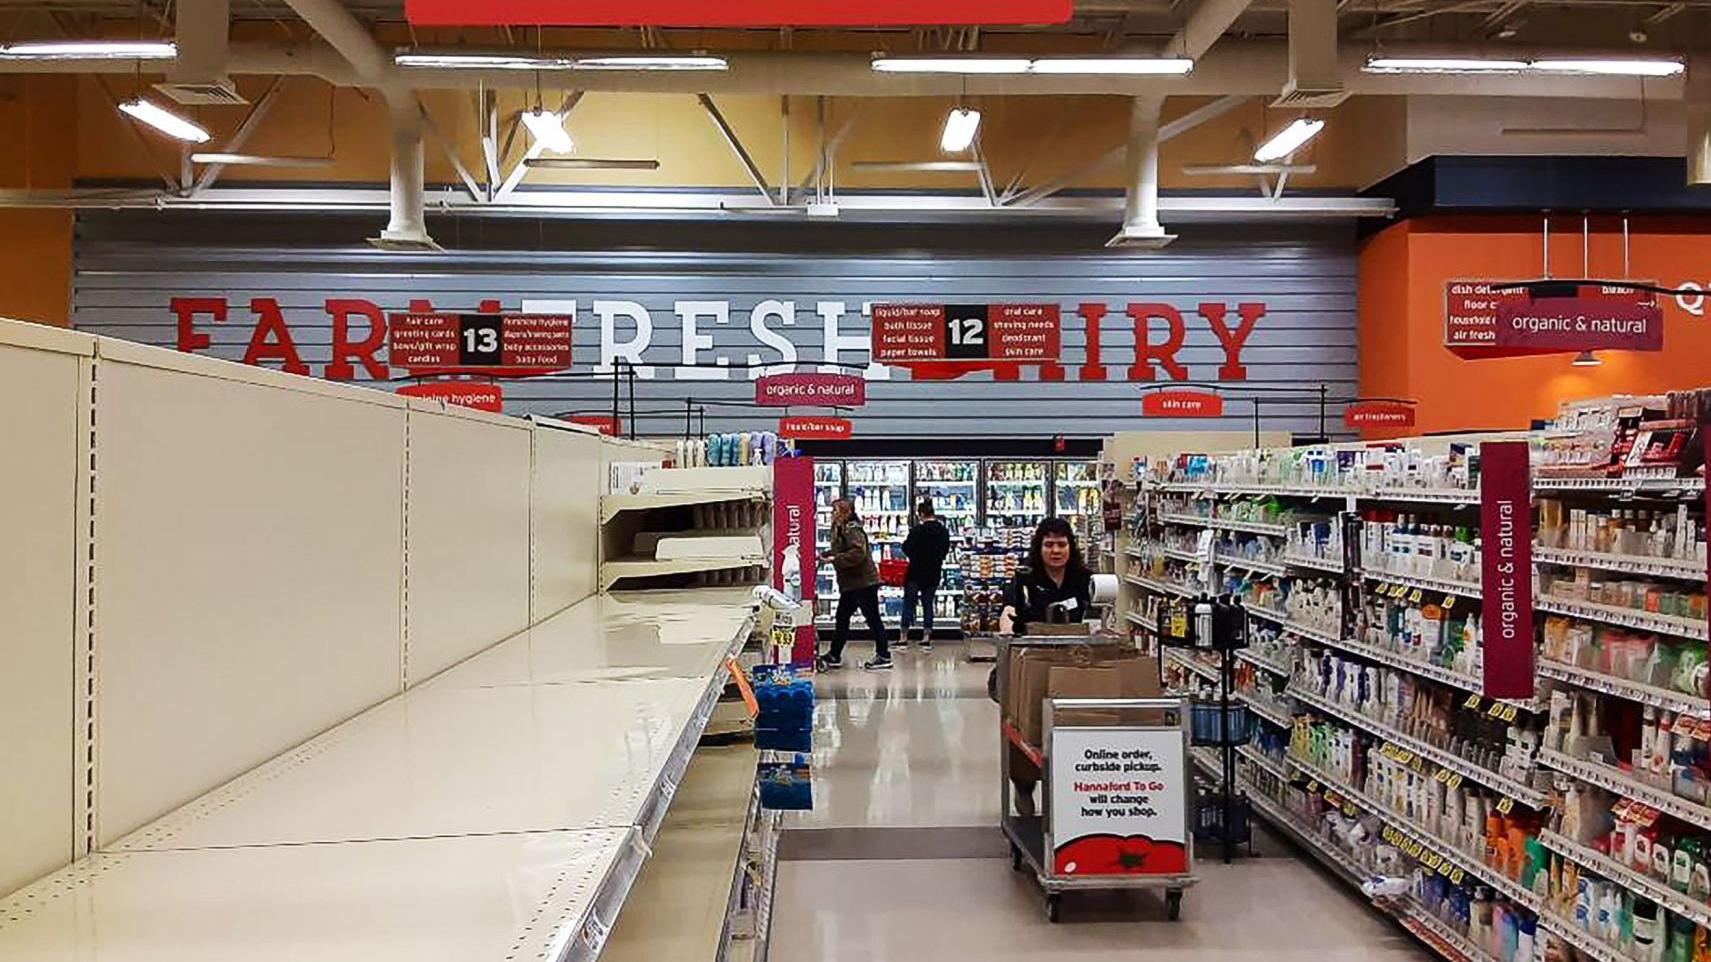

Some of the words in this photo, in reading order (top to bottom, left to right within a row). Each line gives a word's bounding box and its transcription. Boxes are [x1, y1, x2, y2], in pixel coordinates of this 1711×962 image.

[1451, 285, 1473, 294] dish
[1464, 300, 1486, 309] floor
[1675, 281, 1705, 316] Q
[1512, 315, 1571, 333] organic
[1575, 316, 1587, 332] &
[1591, 318, 1647, 333] natural
[948, 318, 984, 345] 12
[1453, 330, 1465, 339] air
[1469, 330, 1496, 339] fresh
[170, 297, 500, 380] FAR
[522, 299, 890, 380] RESH
[463, 327, 498, 353] 13
[766, 383, 805, 396] organic
[806, 383, 816, 396] &
[817, 383, 855, 395] natural
[452, 393, 496, 404] hygiene
[786, 505, 801, 547] atural
[1496, 500, 1514, 559] natural
[1497, 560, 1515, 575] &
[1497, 577, 1518, 640] organic
[1084, 749, 1119, 760] Online
[1121, 749, 1153, 760] order,
[1075, 761, 1121, 772] curbside
[1074, 781, 1131, 792] Hannaford
[1133, 782, 1146, 791] To
[1148, 781, 1164, 791] Go
[1089, 794, 1108, 803] will
[1110, 794, 1149, 806] change
[1081, 807, 1103, 816] how
[1105, 808, 1125, 817] you
[1128, 806, 1157, 817] shop.
